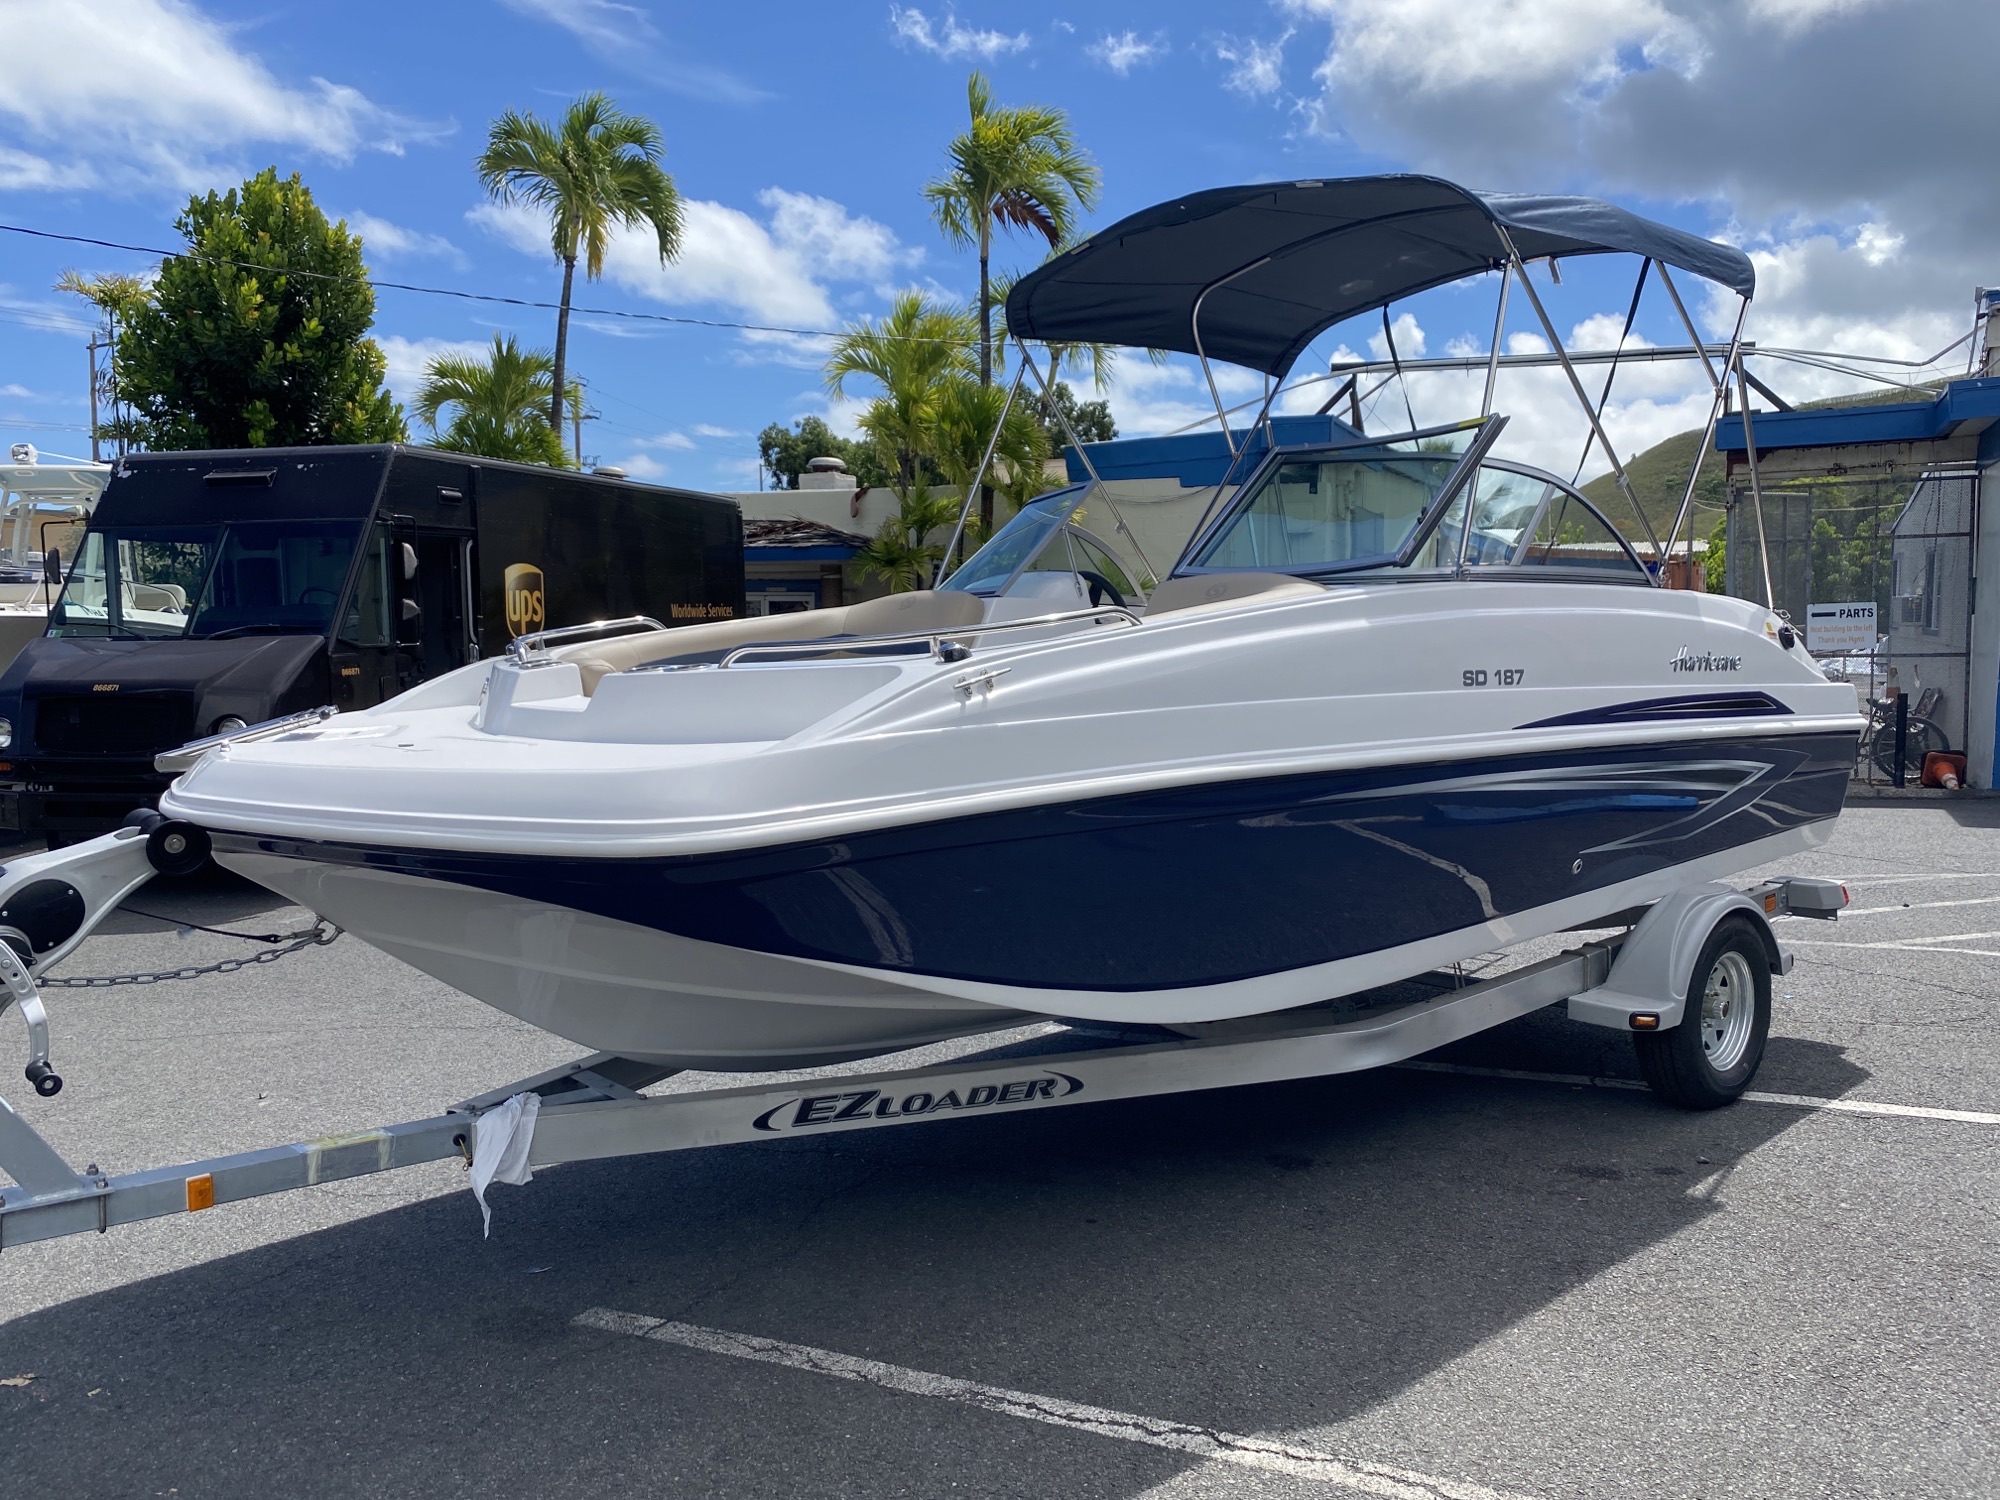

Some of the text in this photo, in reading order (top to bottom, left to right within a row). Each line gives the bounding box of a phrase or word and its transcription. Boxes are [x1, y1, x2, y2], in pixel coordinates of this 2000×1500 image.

[671, 603, 733, 618] Worldwide Services
[1839, 607, 1874, 618] PARTS
[1823, 624, 1845, 633] building
[1863, 623, 1873, 631] left
[1670, 644, 1742, 672] Hurricane
[1462, 668, 1525, 687] SD 187
